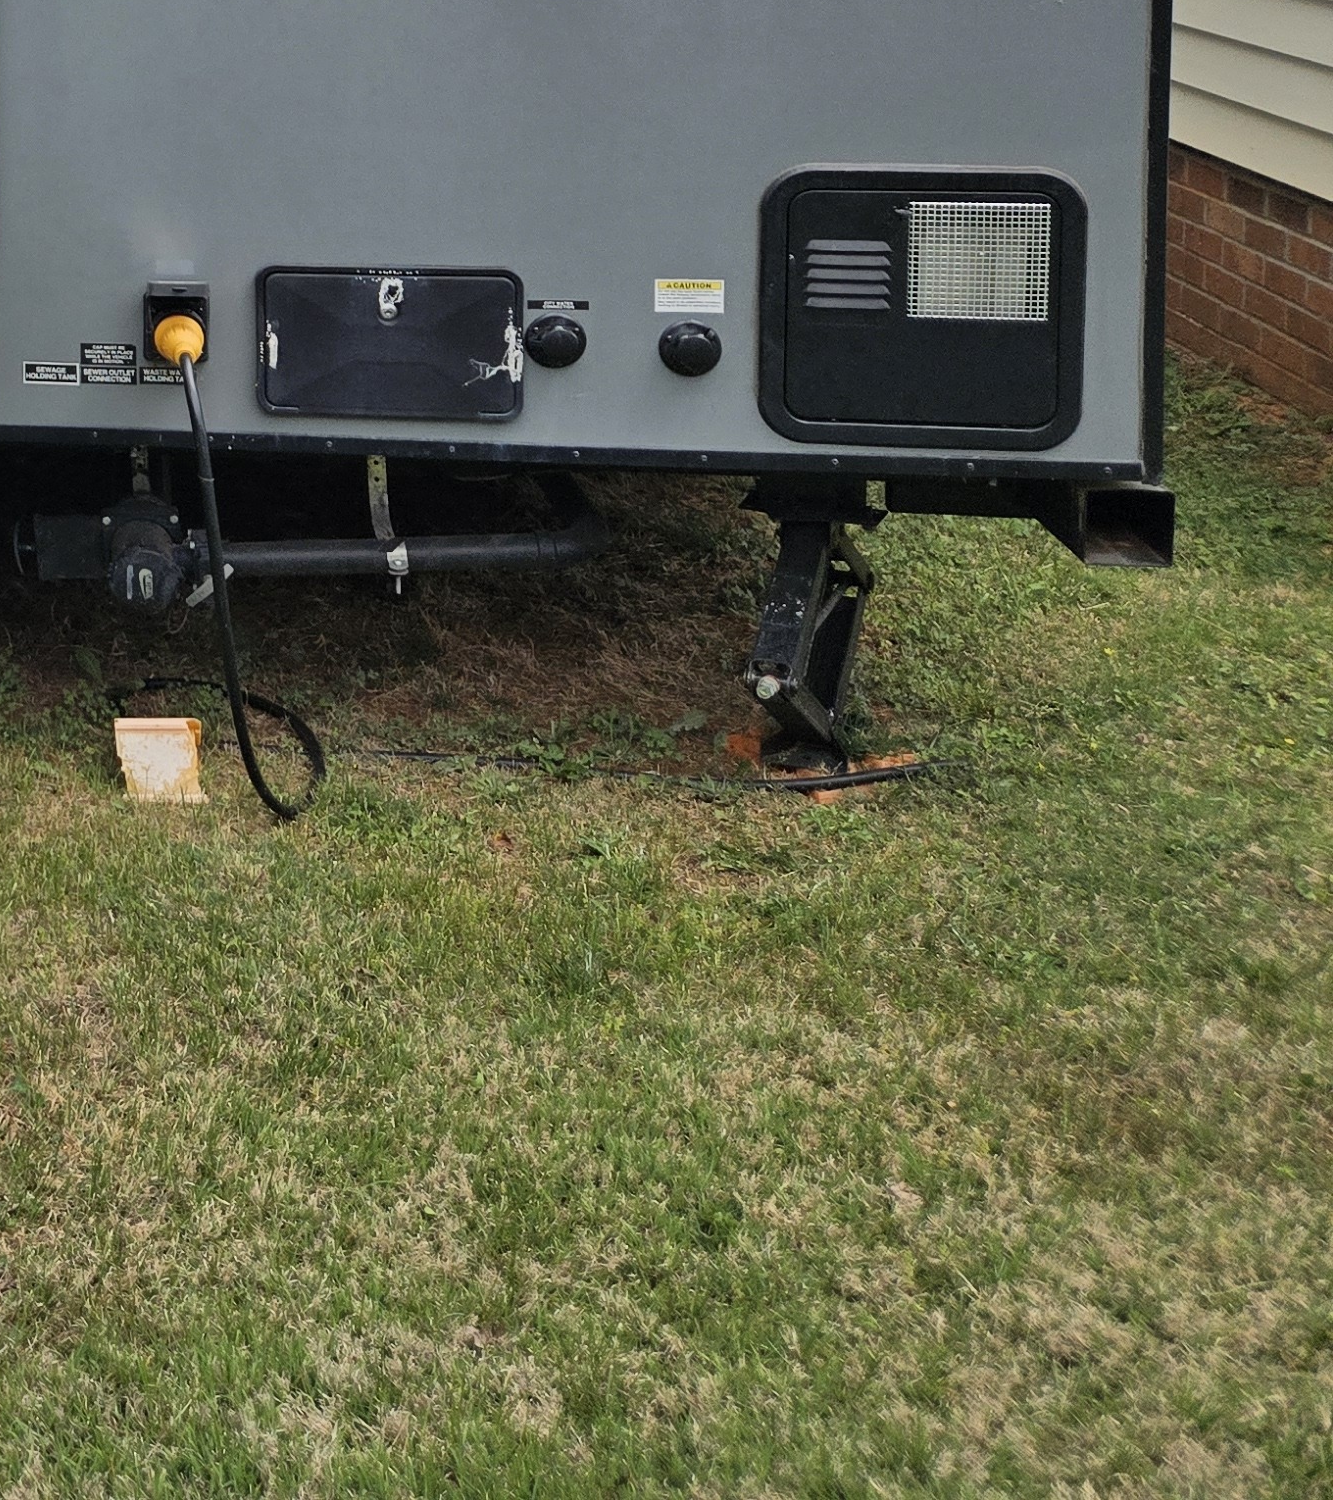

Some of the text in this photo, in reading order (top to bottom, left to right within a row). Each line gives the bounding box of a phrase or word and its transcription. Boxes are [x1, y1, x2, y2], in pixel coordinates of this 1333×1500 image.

[83, 368, 108, 376] SEWER
[57, 373, 77, 381] TANK
[88, 375, 132, 383] CONNECTION
